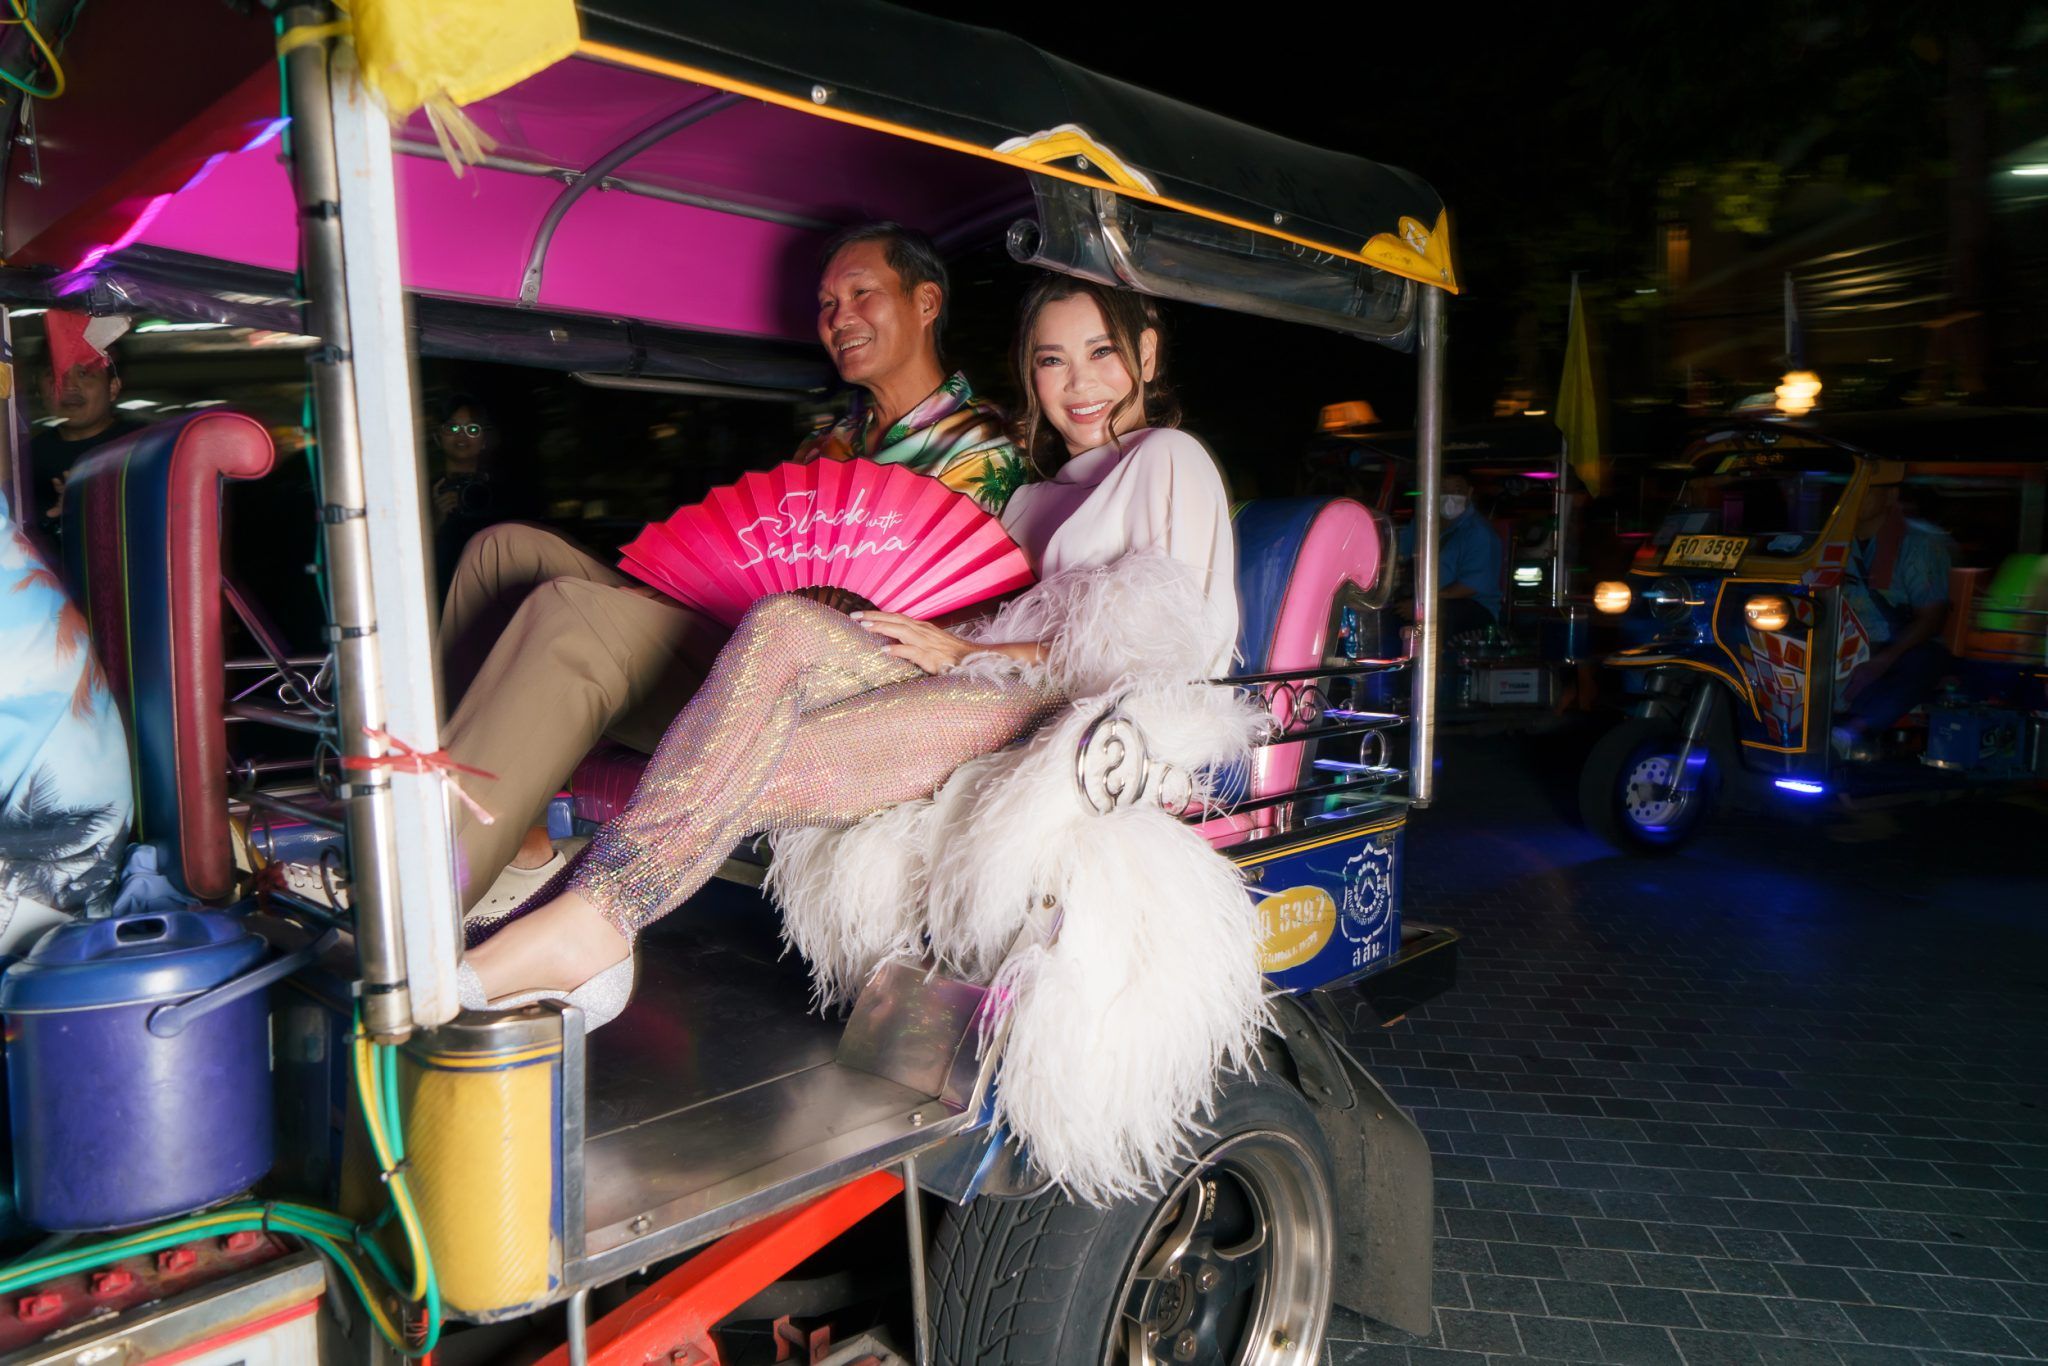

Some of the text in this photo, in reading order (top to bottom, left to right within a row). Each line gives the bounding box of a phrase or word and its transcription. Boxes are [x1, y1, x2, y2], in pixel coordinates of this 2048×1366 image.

[866, 511, 904, 535] with
[733, 516, 917, 570] Susanna
[1704, 539, 1744, 557] 3598
